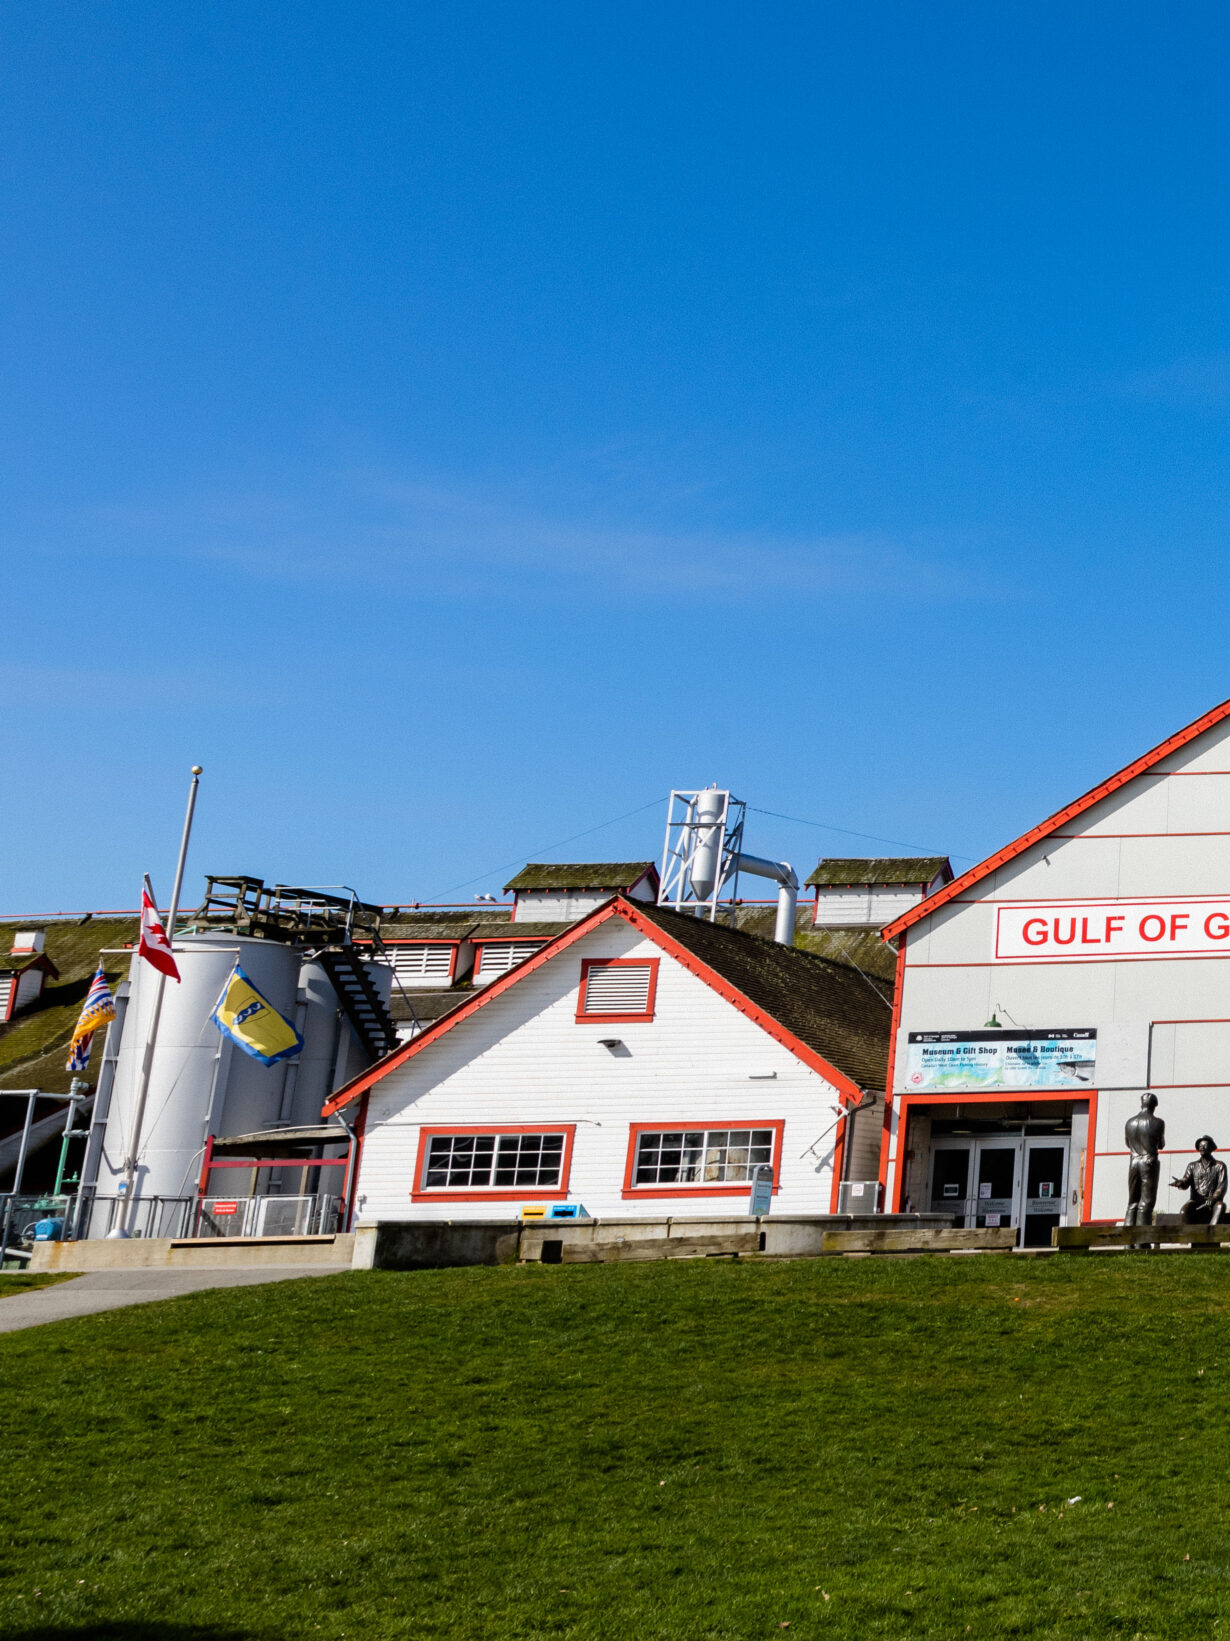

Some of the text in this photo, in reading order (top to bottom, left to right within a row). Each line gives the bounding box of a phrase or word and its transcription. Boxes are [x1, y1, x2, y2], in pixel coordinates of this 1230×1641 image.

[1021, 915, 1126, 946] GULF
[1138, 913, 1190, 942] OF
[922, 1046, 998, 1056] Museum & Gift Shop
[1040, 1045, 1074, 1054] Boutique
